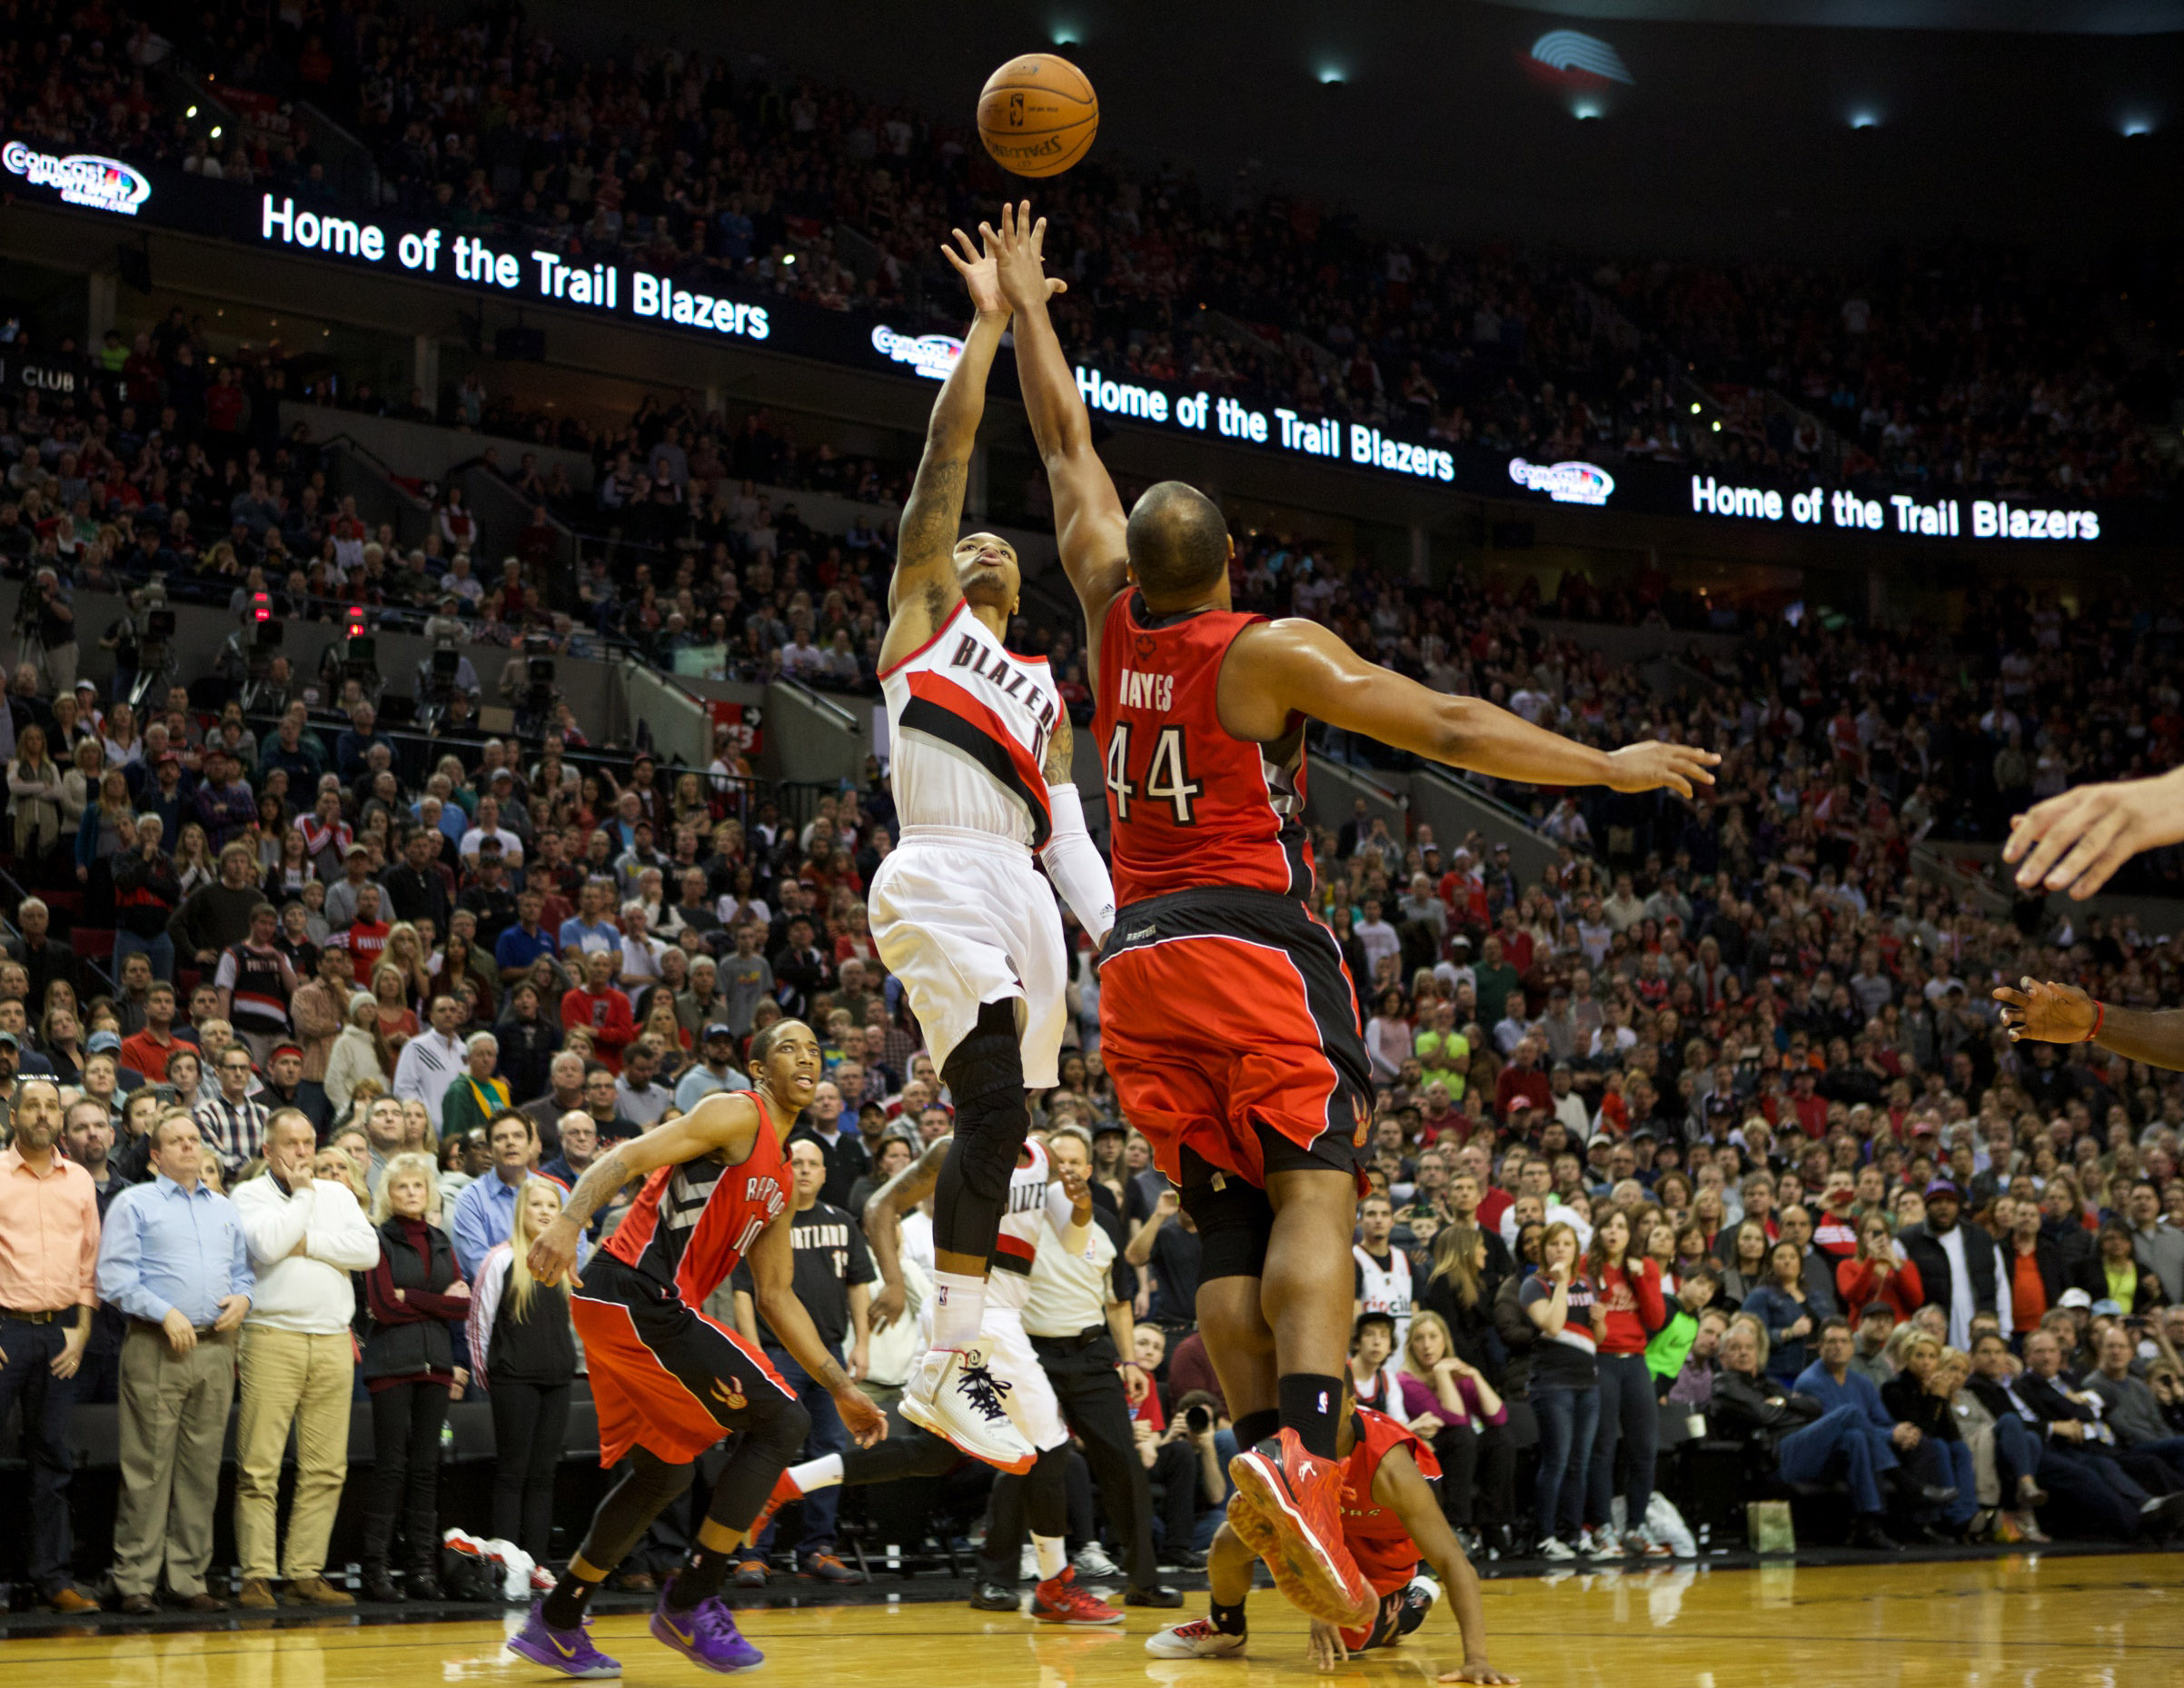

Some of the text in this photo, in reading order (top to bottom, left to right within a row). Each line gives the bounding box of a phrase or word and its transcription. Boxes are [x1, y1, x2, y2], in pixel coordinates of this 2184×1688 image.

[263, 193, 769, 340] Home of the Trail Blazers
[22, 365, 75, 393] CLUB
[1076, 365, 1455, 482] Home of the Trail Blazers
[1692, 474, 2100, 540] Home of the Trail Blazers
[949, 632, 1057, 738] BLAZER
[1106, 720, 1205, 827] 44
[357, 937, 385, 950] PORTLA
[732, 1213, 764, 1257] 10
[789, 1223, 849, 1249] RTLAND
